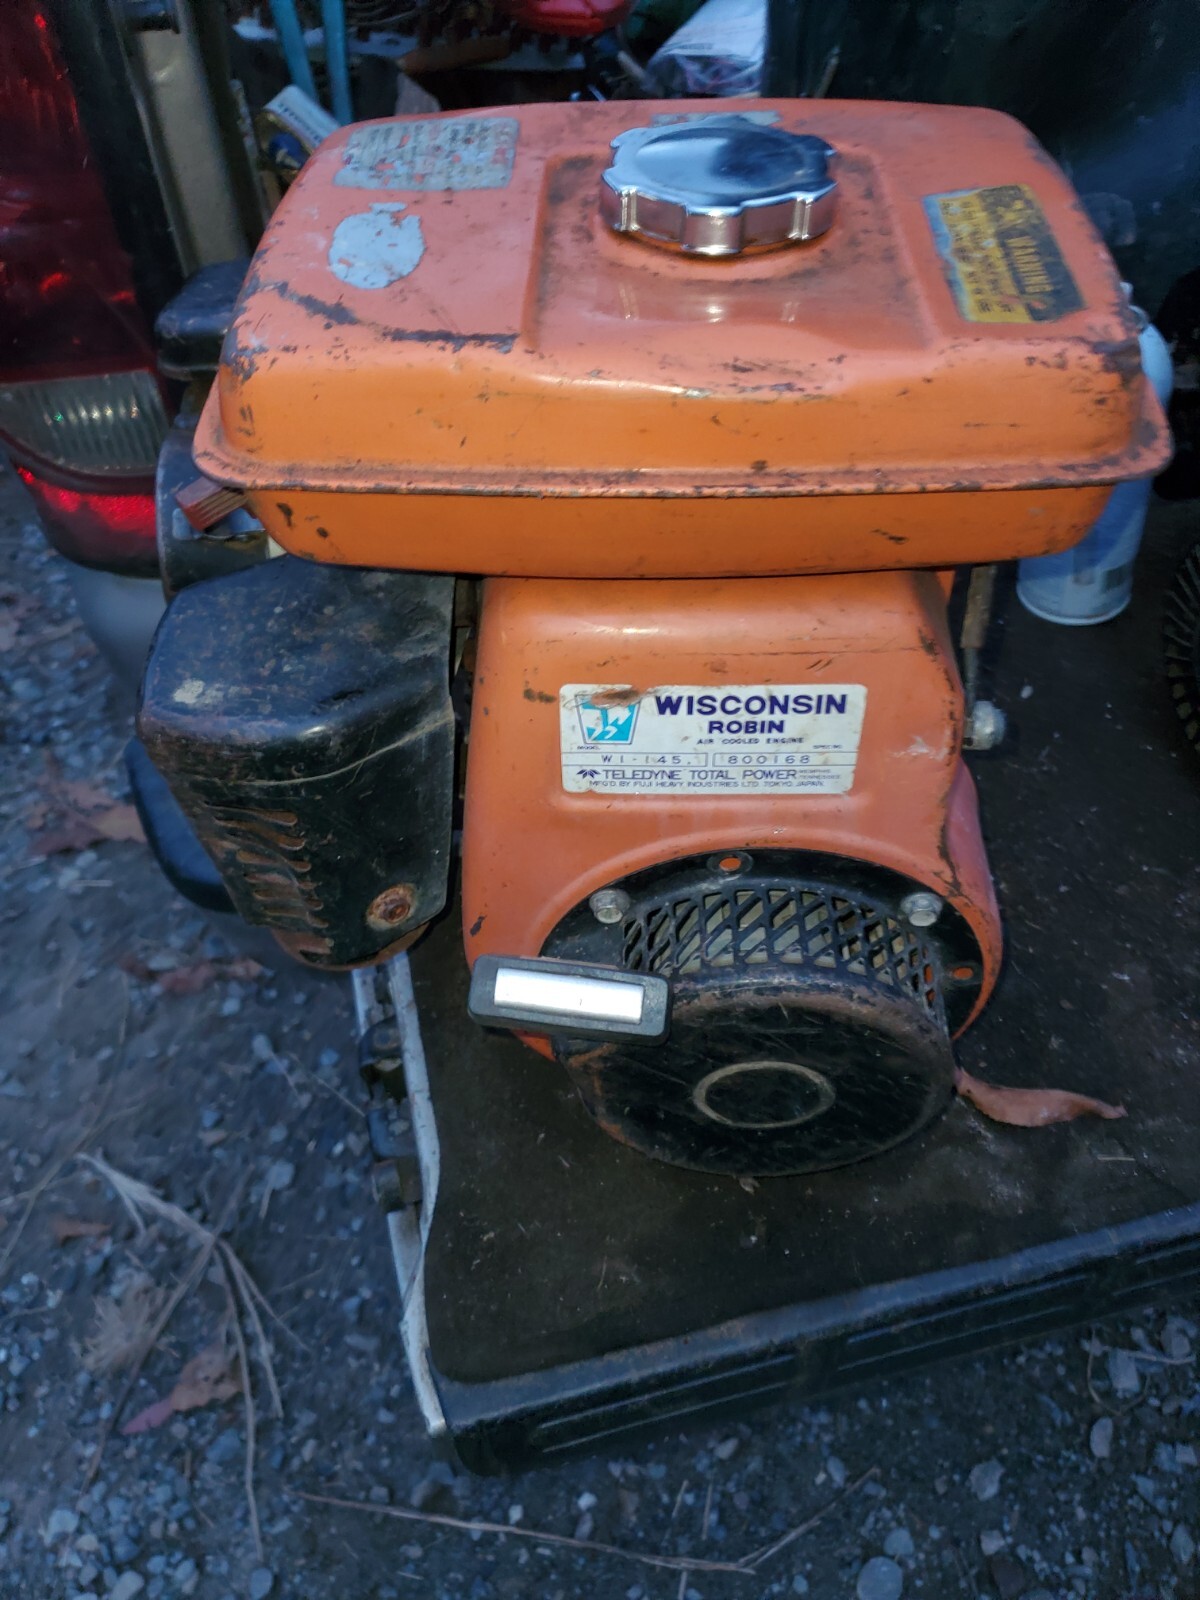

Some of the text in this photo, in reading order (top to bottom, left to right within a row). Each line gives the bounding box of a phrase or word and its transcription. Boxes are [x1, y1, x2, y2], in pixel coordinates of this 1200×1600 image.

[655, 694, 847, 716] WISCONSIN
[708, 719, 785, 734] ROBIN
[728, 754, 810, 764] 800168
[602, 769, 797, 780] TELEDYNE TOTAL POWER
[656, 780, 684, 788] HEAVY
[687, 780, 739, 788] INDUSTRIES
